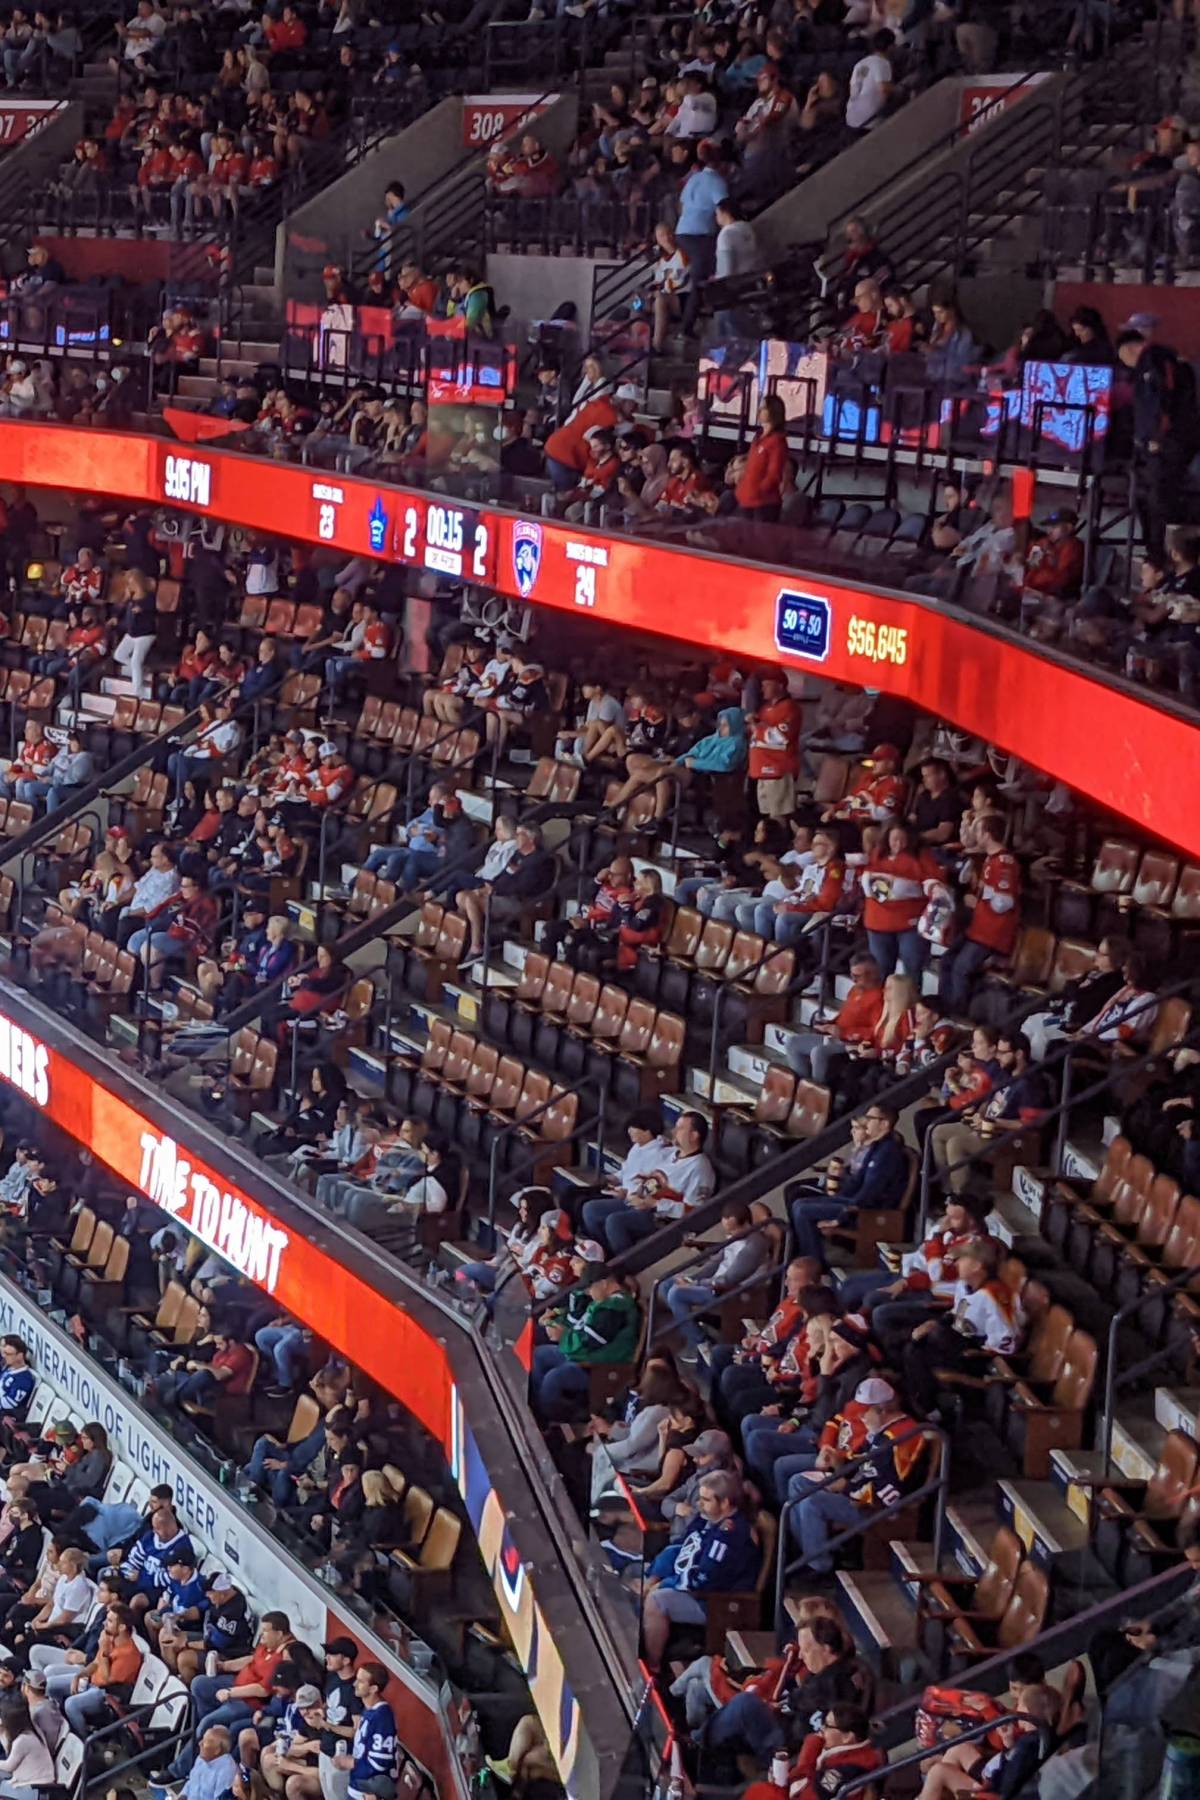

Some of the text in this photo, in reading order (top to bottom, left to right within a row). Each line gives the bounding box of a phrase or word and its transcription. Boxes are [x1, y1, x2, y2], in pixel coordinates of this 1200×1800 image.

[165, 455, 211, 506] 9:05 PM
[403, 507, 418, 557] 2
[426, 505, 464, 551] 00:15
[472, 525, 488, 577] 2
[575, 565, 596, 608] 24
[782, 608, 822, 637] 50 50
[847, 614, 908, 665] $56,645
[141, 1132, 289, 1294] TIME TO HUNT
[18, 1319, 100, 1420] GENERATION
[104, 1403, 123, 1438] OF
[128, 1426, 171, 1484] LIGHT
[176, 1475, 216, 1540] BEER
[710, 1539, 728, 1562] 11
[372, 1733, 394, 1753] 34
